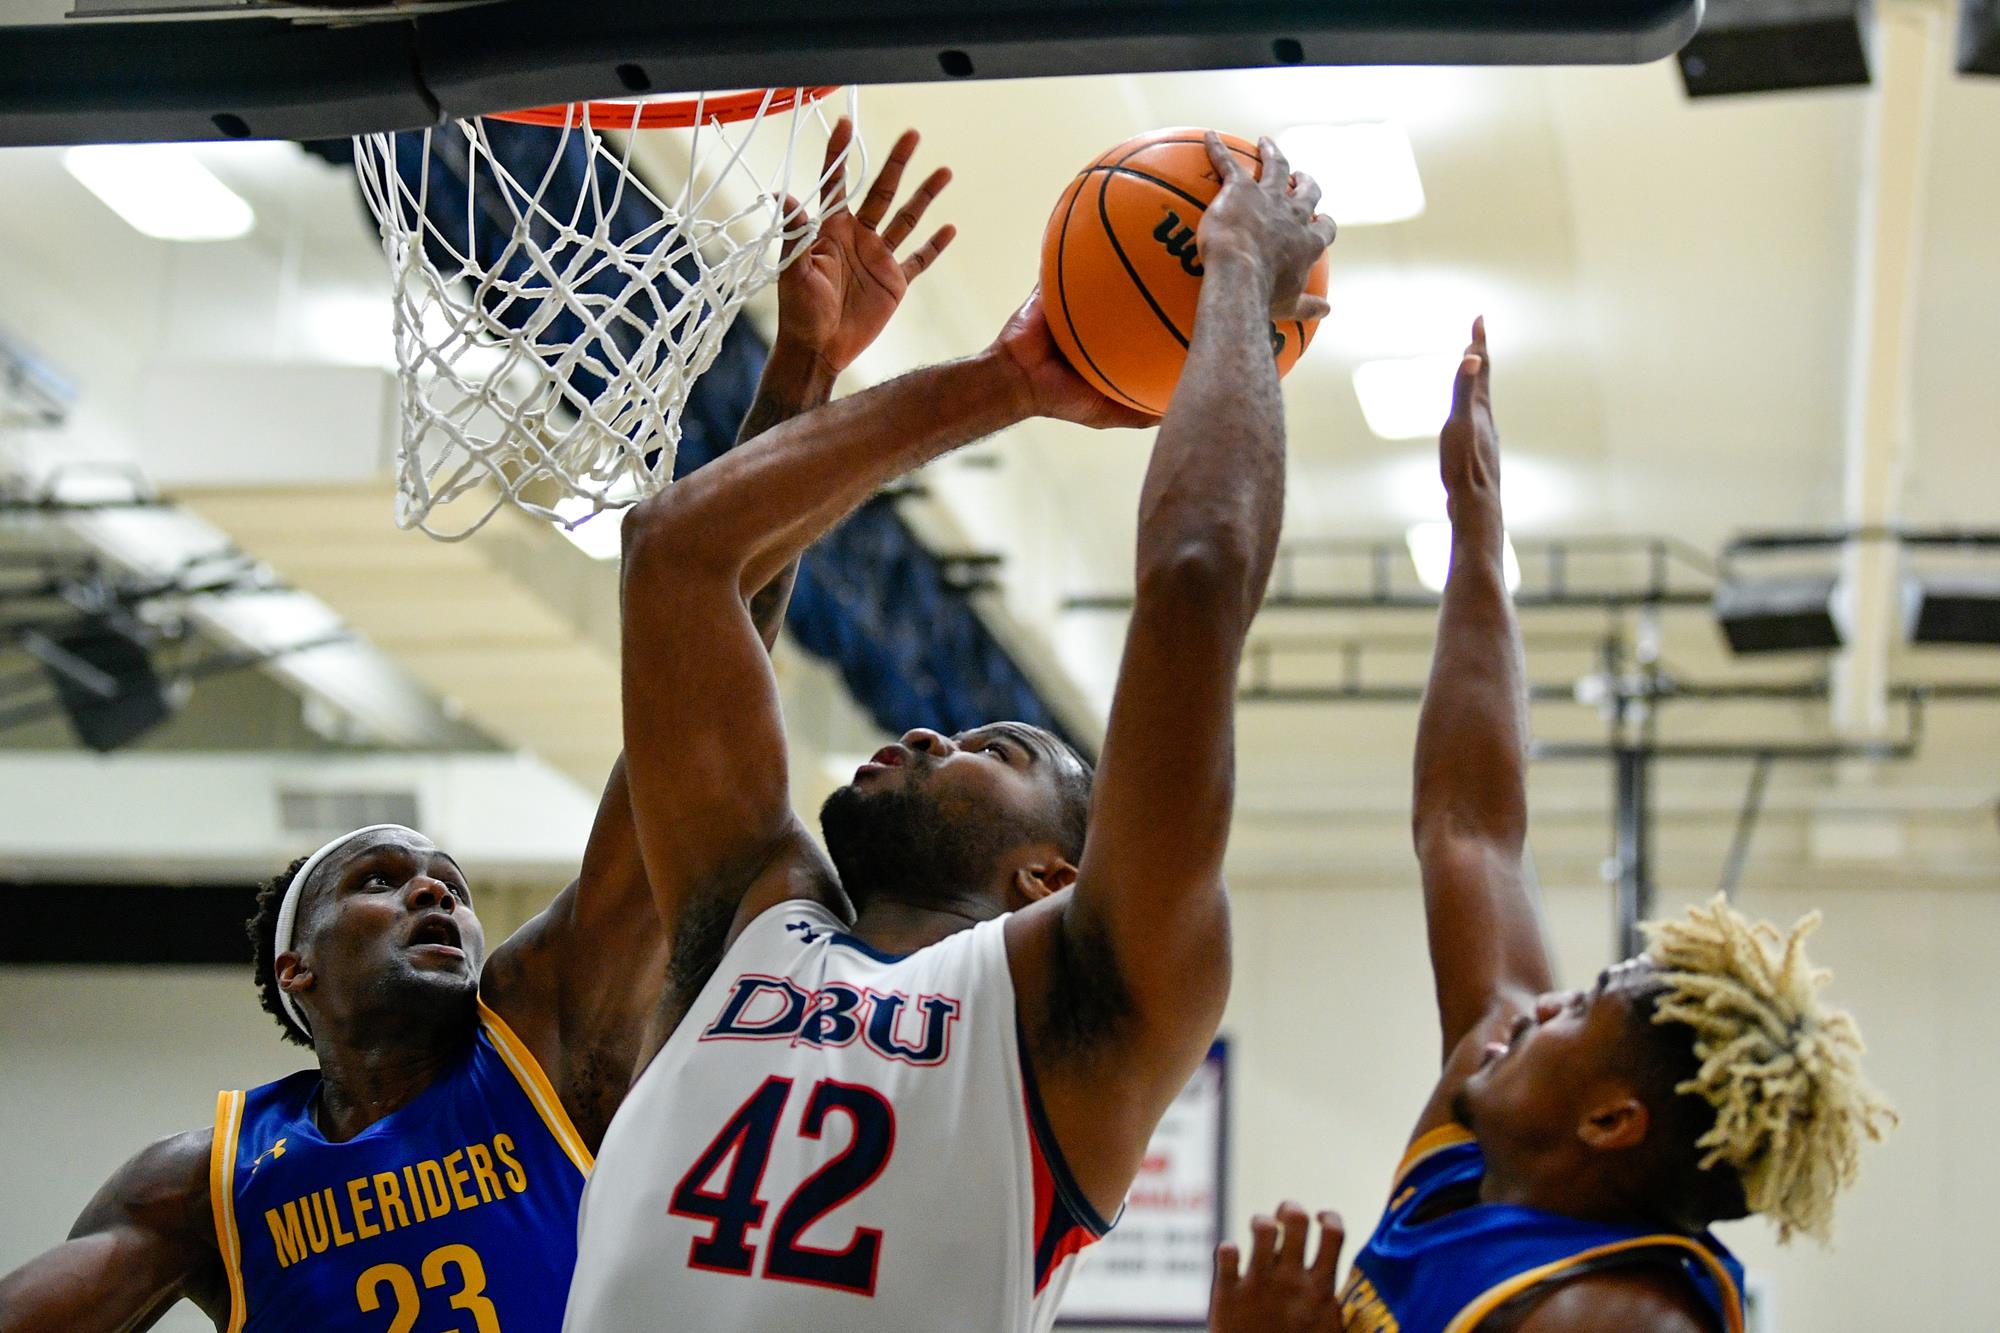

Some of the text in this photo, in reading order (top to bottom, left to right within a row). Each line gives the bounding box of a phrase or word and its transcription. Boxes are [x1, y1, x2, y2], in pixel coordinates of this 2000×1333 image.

[699, 973, 960, 1067] DBU
[265, 1133, 528, 1268] MULERIDERS
[667, 1074, 896, 1297] 42
[356, 1243, 501, 1333] 23
